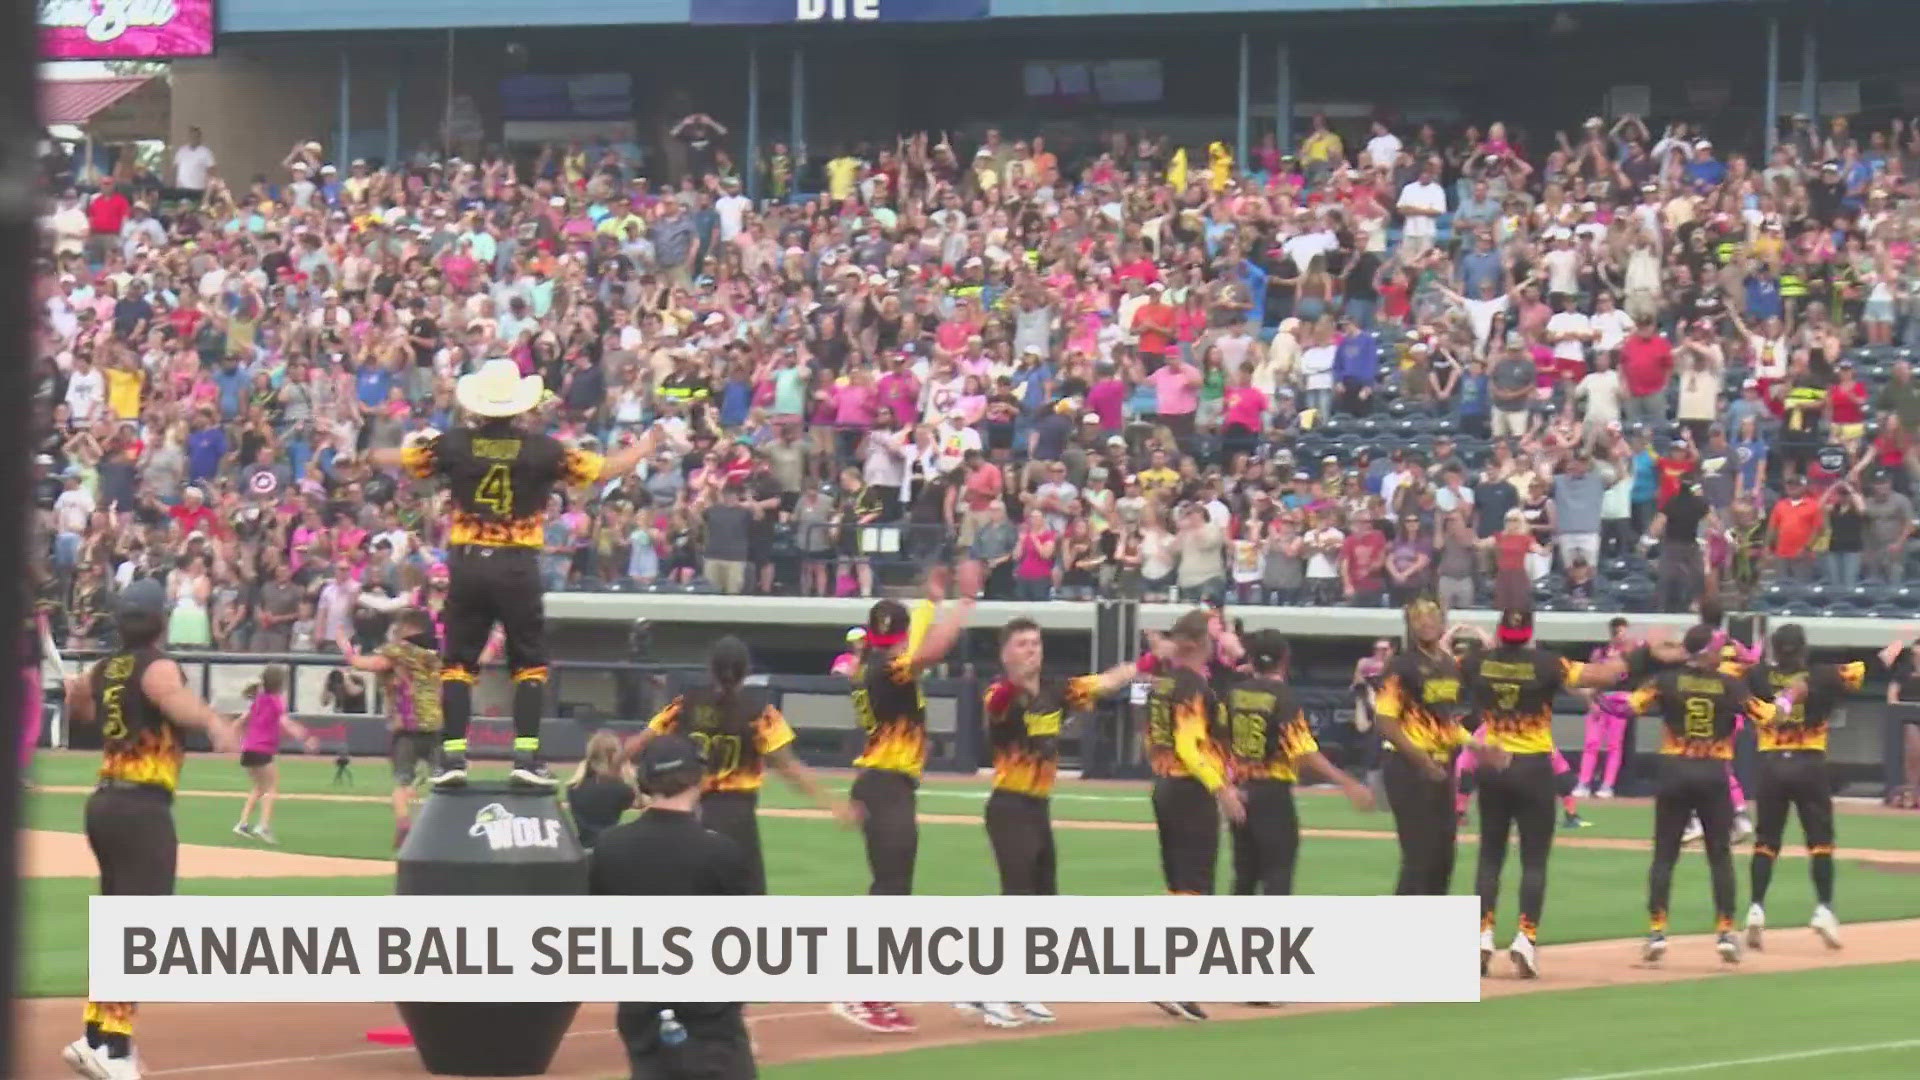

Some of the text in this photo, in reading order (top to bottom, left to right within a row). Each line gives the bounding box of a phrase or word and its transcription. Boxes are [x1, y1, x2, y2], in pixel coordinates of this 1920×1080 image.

[475, 464, 513, 514] 4
[1684, 696, 1715, 738] 2
[486, 816, 561, 850] WOLF
